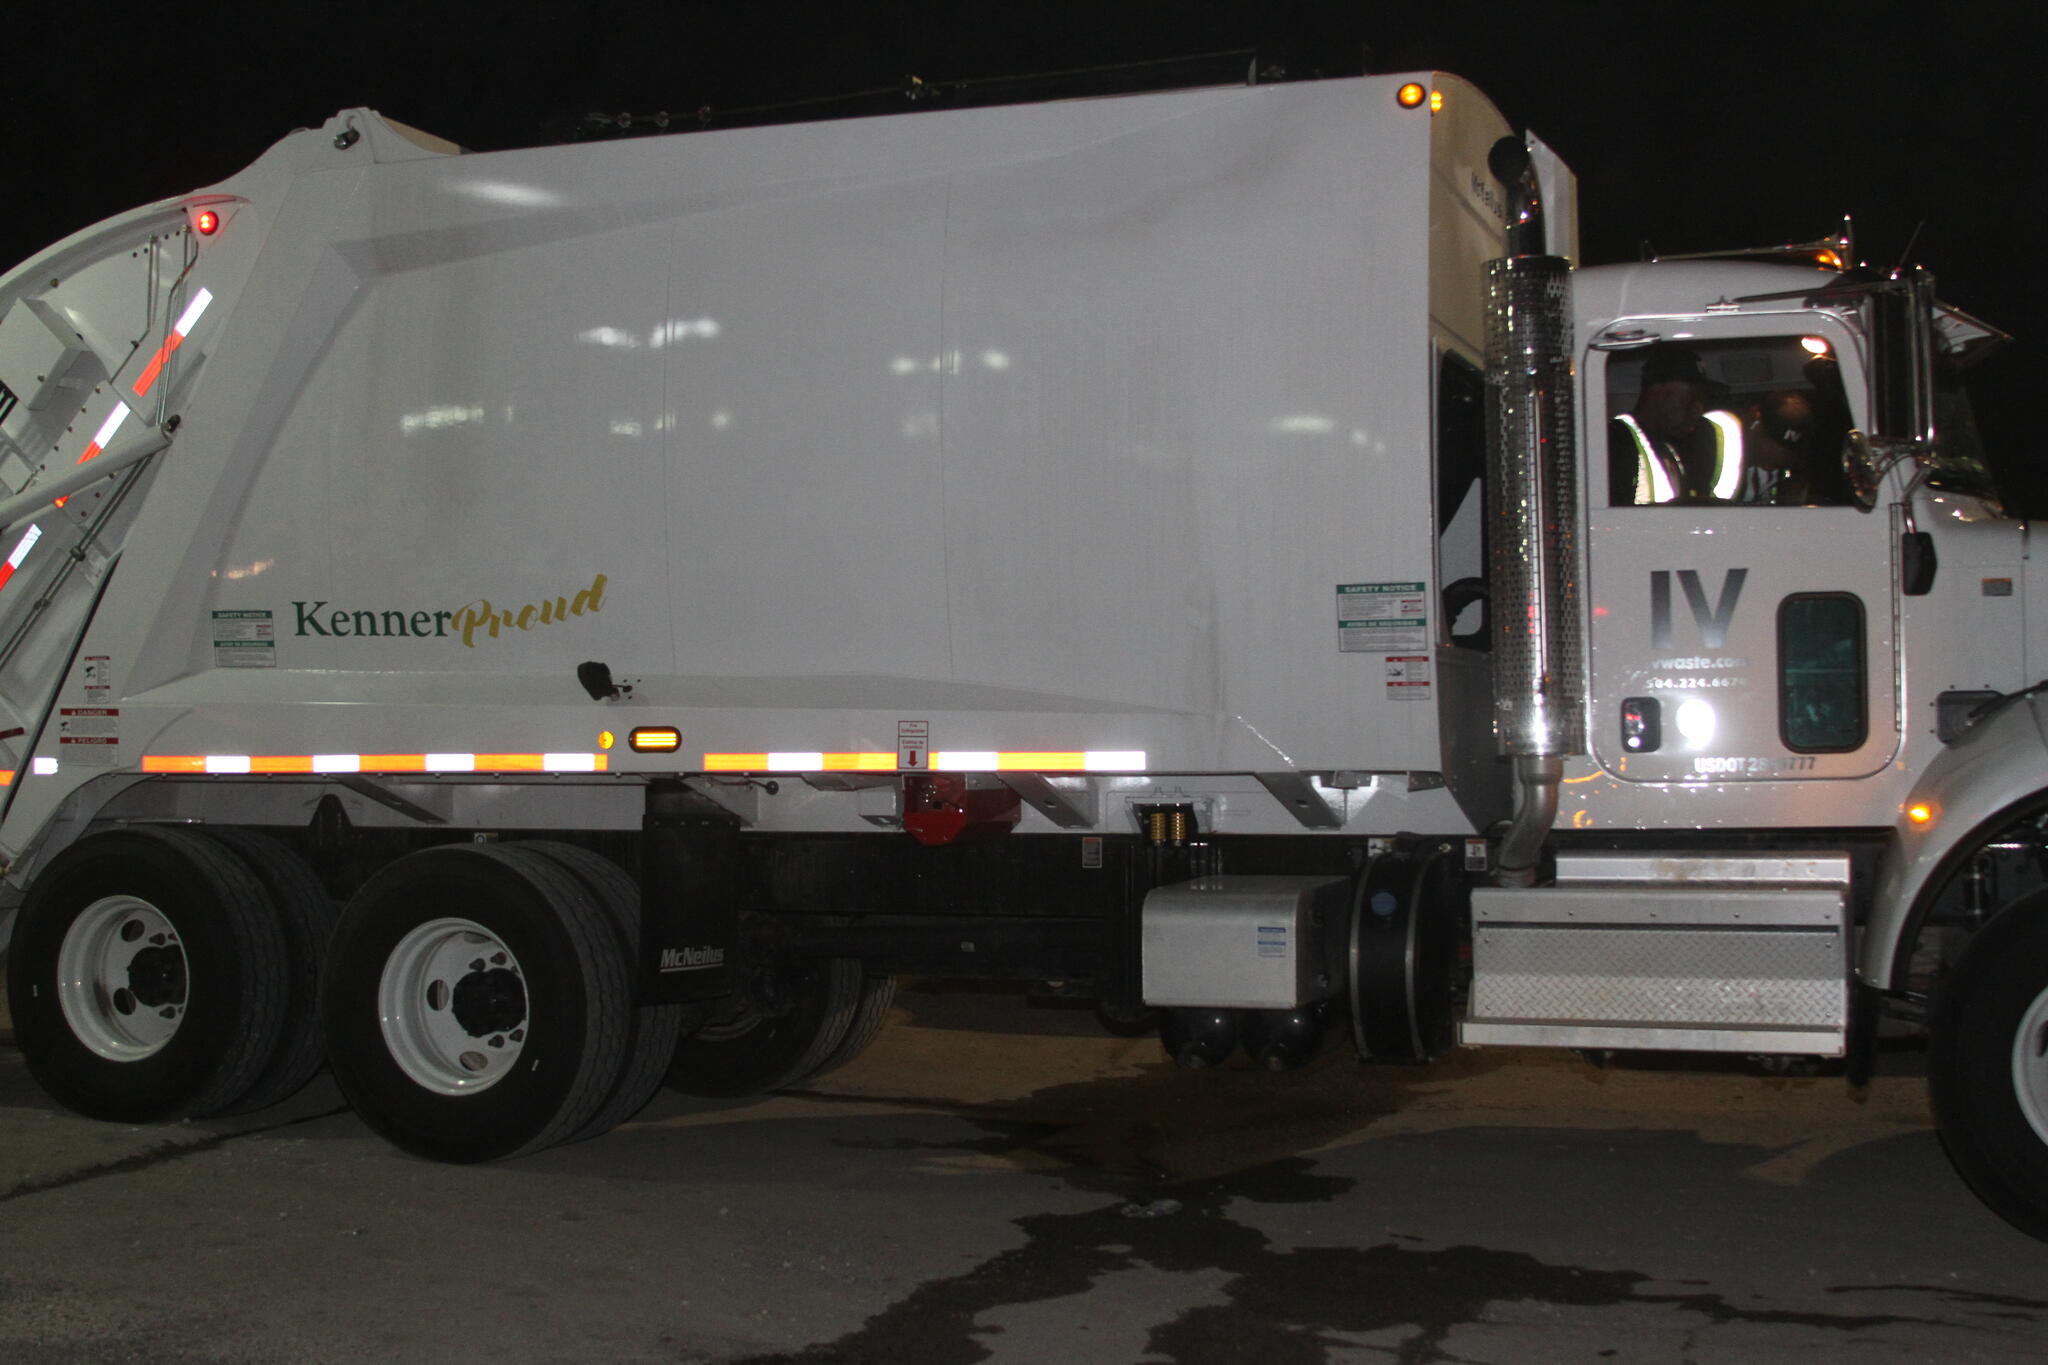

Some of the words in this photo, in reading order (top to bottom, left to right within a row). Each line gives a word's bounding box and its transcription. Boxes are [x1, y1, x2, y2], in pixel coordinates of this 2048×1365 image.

[292, 601, 453, 637] Kenner
[451, 573, 608, 648] Proud
[1651, 568, 1748, 649] IV
[1694, 757, 1745, 773] USDOT
[661, 945, 724, 968] McNeilus
